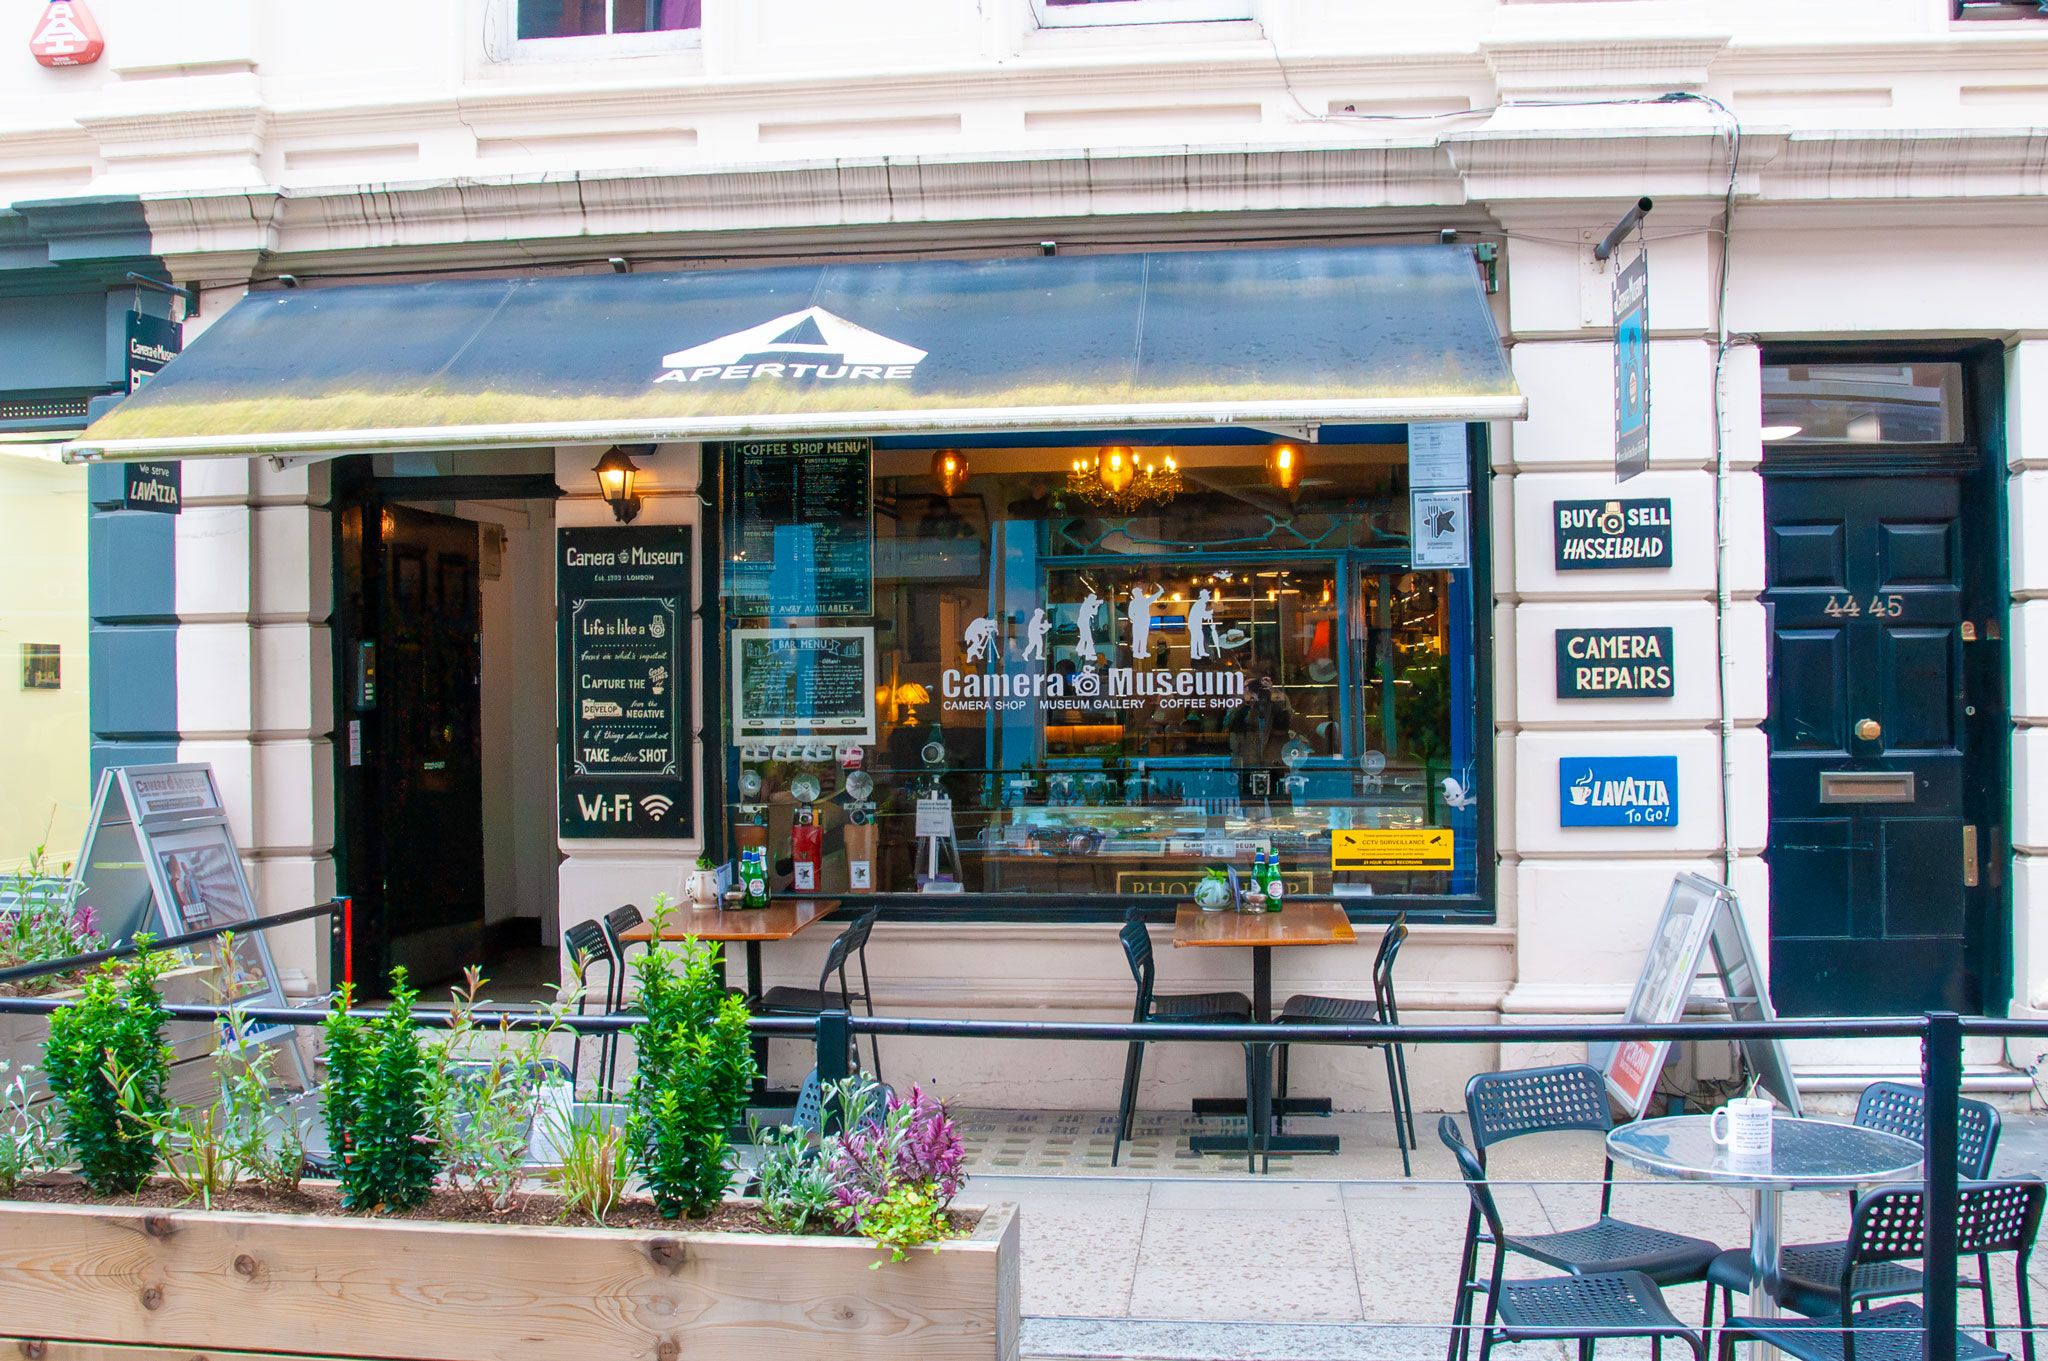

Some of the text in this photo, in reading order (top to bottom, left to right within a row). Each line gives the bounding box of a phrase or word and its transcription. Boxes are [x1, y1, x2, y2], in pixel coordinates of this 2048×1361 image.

[652, 362, 916, 384] APERTURE
[743, 441, 861, 456] COFFEE SHOP MENU
[139, 464, 170, 477] We serve
[130, 479, 178, 504] LAVAZZA
[1560, 507, 1670, 529] BUY SELL
[566, 546, 684, 567] Camera Museum
[1563, 537, 1664, 560] HASSELBLAD
[626, 574, 655, 582] LONDON
[755, 603, 849, 614] TAKE AWAY AVAILABLE
[1823, 594, 1904, 618] 44 45
[583, 618, 646, 636] Life is like a
[779, 639, 828, 650] BAR MENU
[1567, 635, 1662, 660] CAMERA
[628, 679, 646, 689] THE
[942, 667, 1245, 698] Camera Museum
[1576, 665, 1671, 690] REPAIRS
[584, 705, 665, 718] DEVELOP NEGATIVE
[943, 700, 1027, 711] CAMERA SHOP
[1039, 699, 1146, 711] MUSEUM GALLERY
[1159, 698, 1244, 710] COFFEE SHOP
[604, 730, 625, 743] things
[583, 748, 668, 763] TAKE another SHOT
[1591, 776, 1670, 807] LAVAZZA
[577, 794, 633, 822] Wi-Fi
[1625, 806, 1671, 824] To Go!
